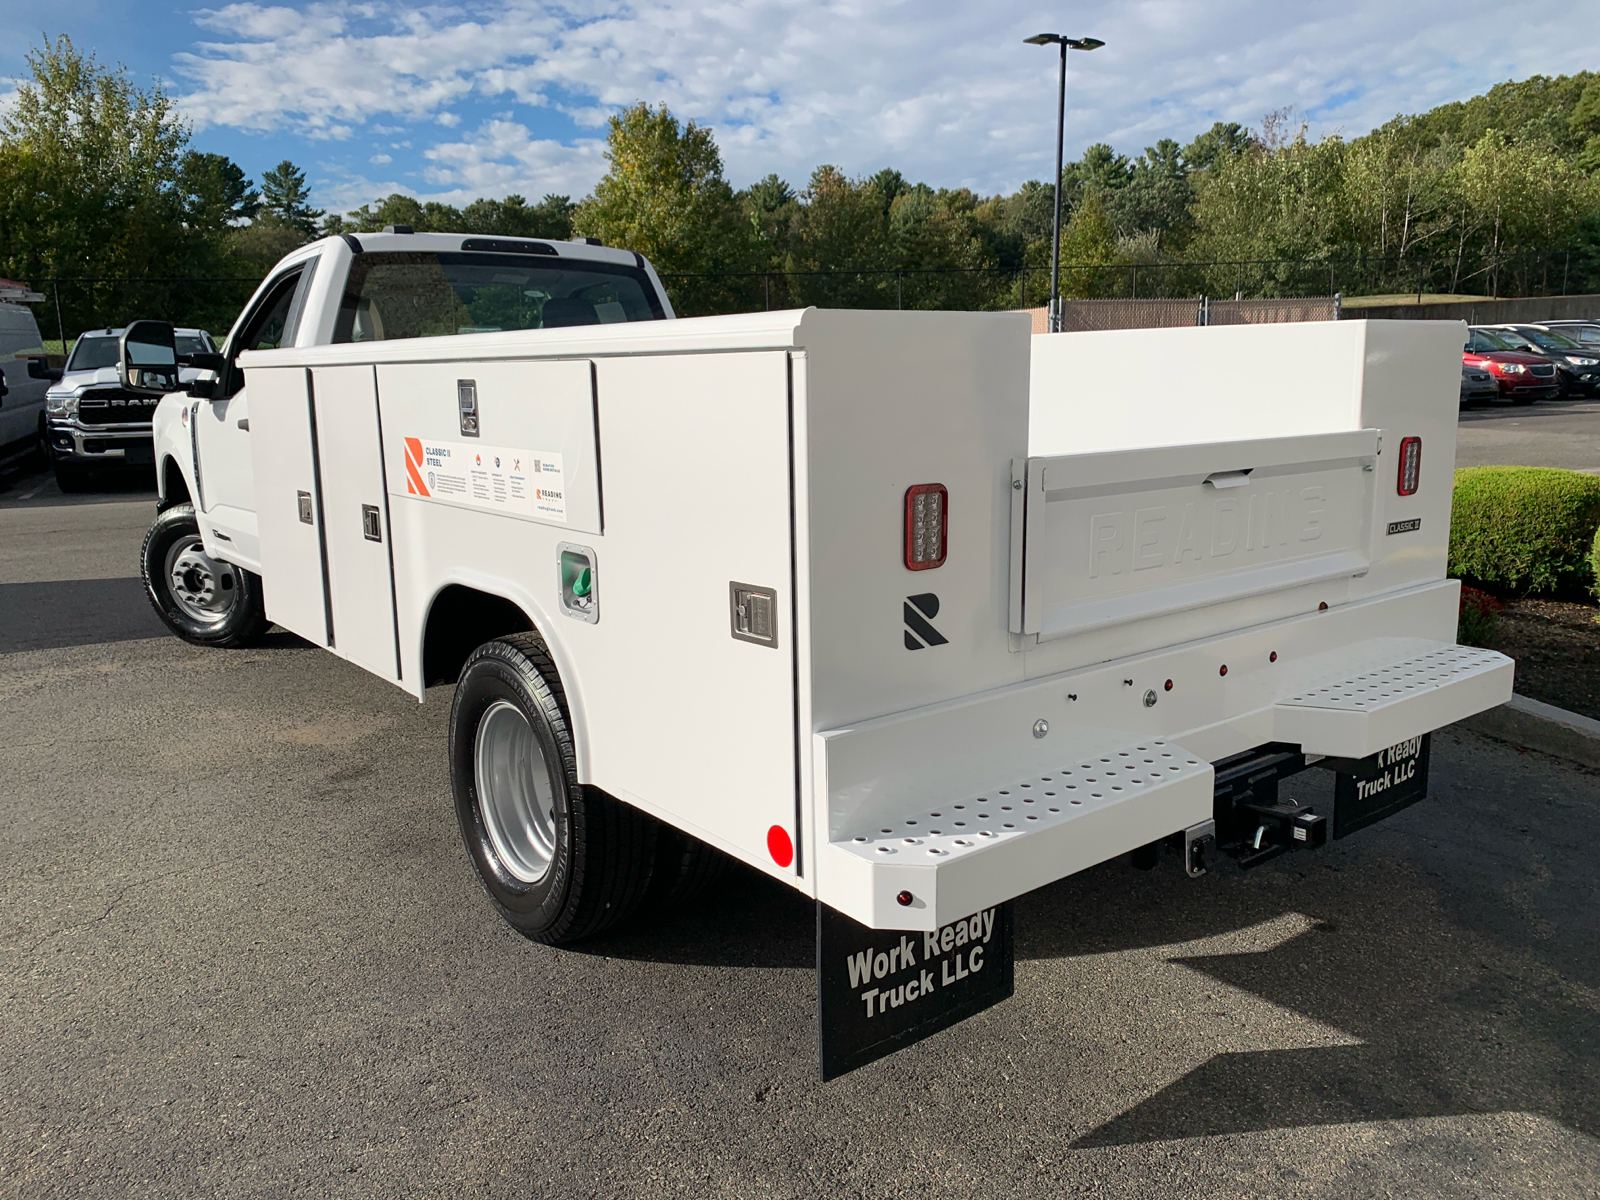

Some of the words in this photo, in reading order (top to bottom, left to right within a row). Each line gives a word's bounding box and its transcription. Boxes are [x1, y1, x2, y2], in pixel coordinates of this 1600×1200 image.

[426, 447, 446, 457] CLASSIC
[427, 458, 442, 467] STEEL
[542, 489, 562, 499] READING
[1089, 486, 1327, 579] READING
[1390, 521, 1413, 533] CLASSIC
[1387, 735, 1422, 765] Ready
[1357, 771, 1391, 800] Truck
[1394, 759, 1415, 785] LLC
[847, 936, 916, 989] Work
[923, 908, 996, 960] Ready
[861, 969, 934, 1018] Truck
[942, 946, 984, 987] LLC
